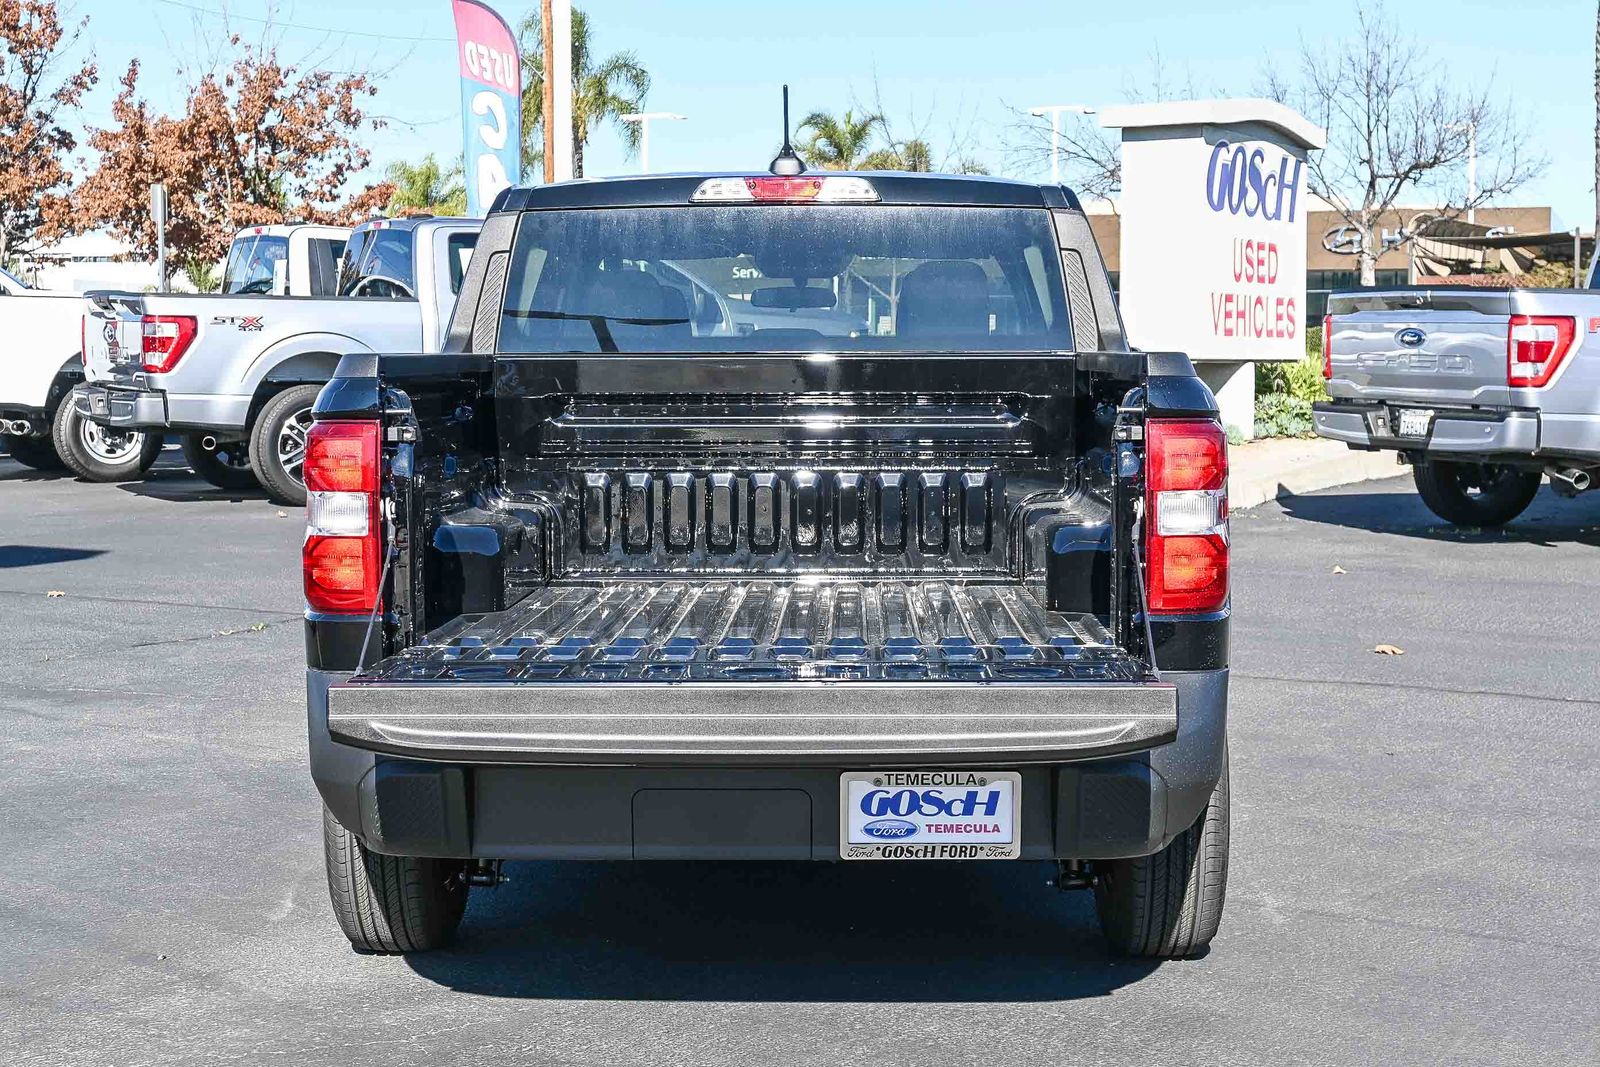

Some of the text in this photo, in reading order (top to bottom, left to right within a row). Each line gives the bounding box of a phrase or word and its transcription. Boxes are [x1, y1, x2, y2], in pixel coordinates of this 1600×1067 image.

[1233, 238, 1279, 285] USED
[210, 316, 264, 328] STX
[1211, 292, 1296, 339] VEHICLES
[884, 773, 977, 786] TEMECULA
[872, 822, 908, 837] Ford
[925, 823, 1001, 833] TEMECULA
[847, 846, 875, 858] Ford
[940, 845, 977, 858] FORD
[985, 846, 1012, 858] Ford
